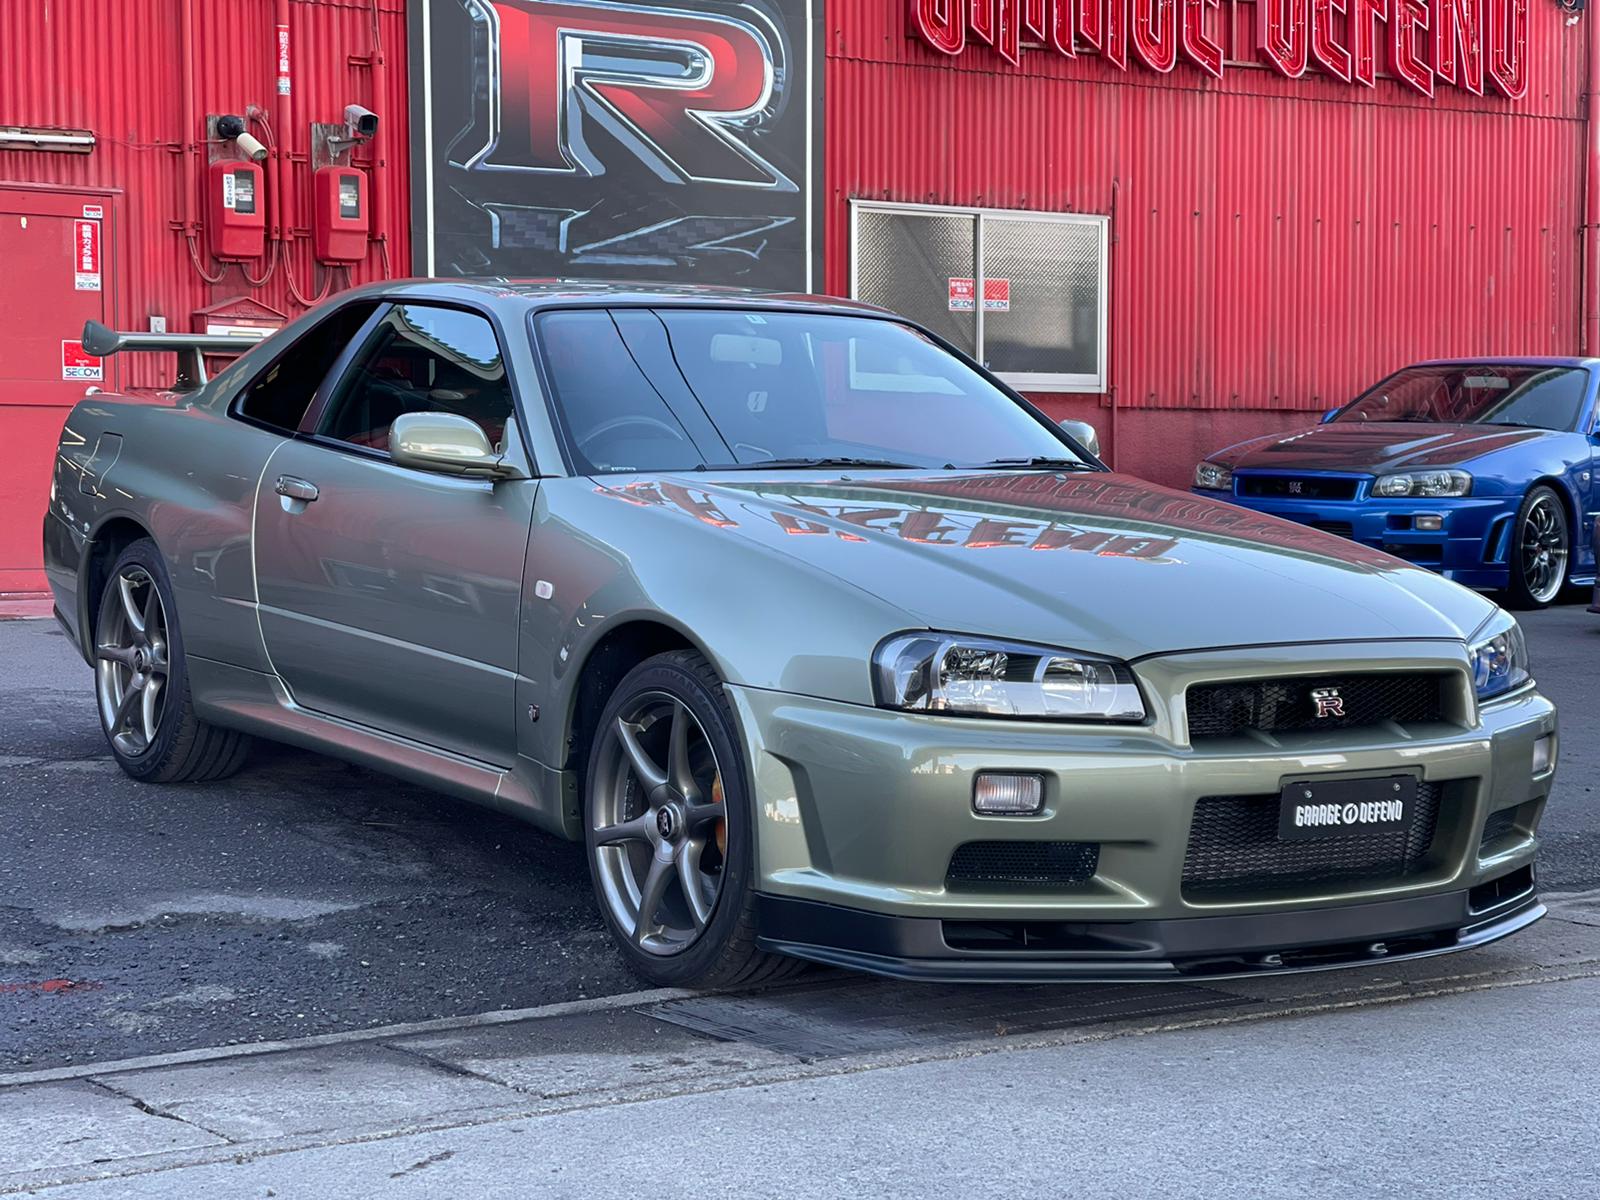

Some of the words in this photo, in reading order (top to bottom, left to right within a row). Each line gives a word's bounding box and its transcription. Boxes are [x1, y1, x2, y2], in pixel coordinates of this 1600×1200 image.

[65, 367, 100, 377] SECOM
[1295, 803, 1342, 827] GARAGE
[1360, 799, 1404, 824] DEFEND
